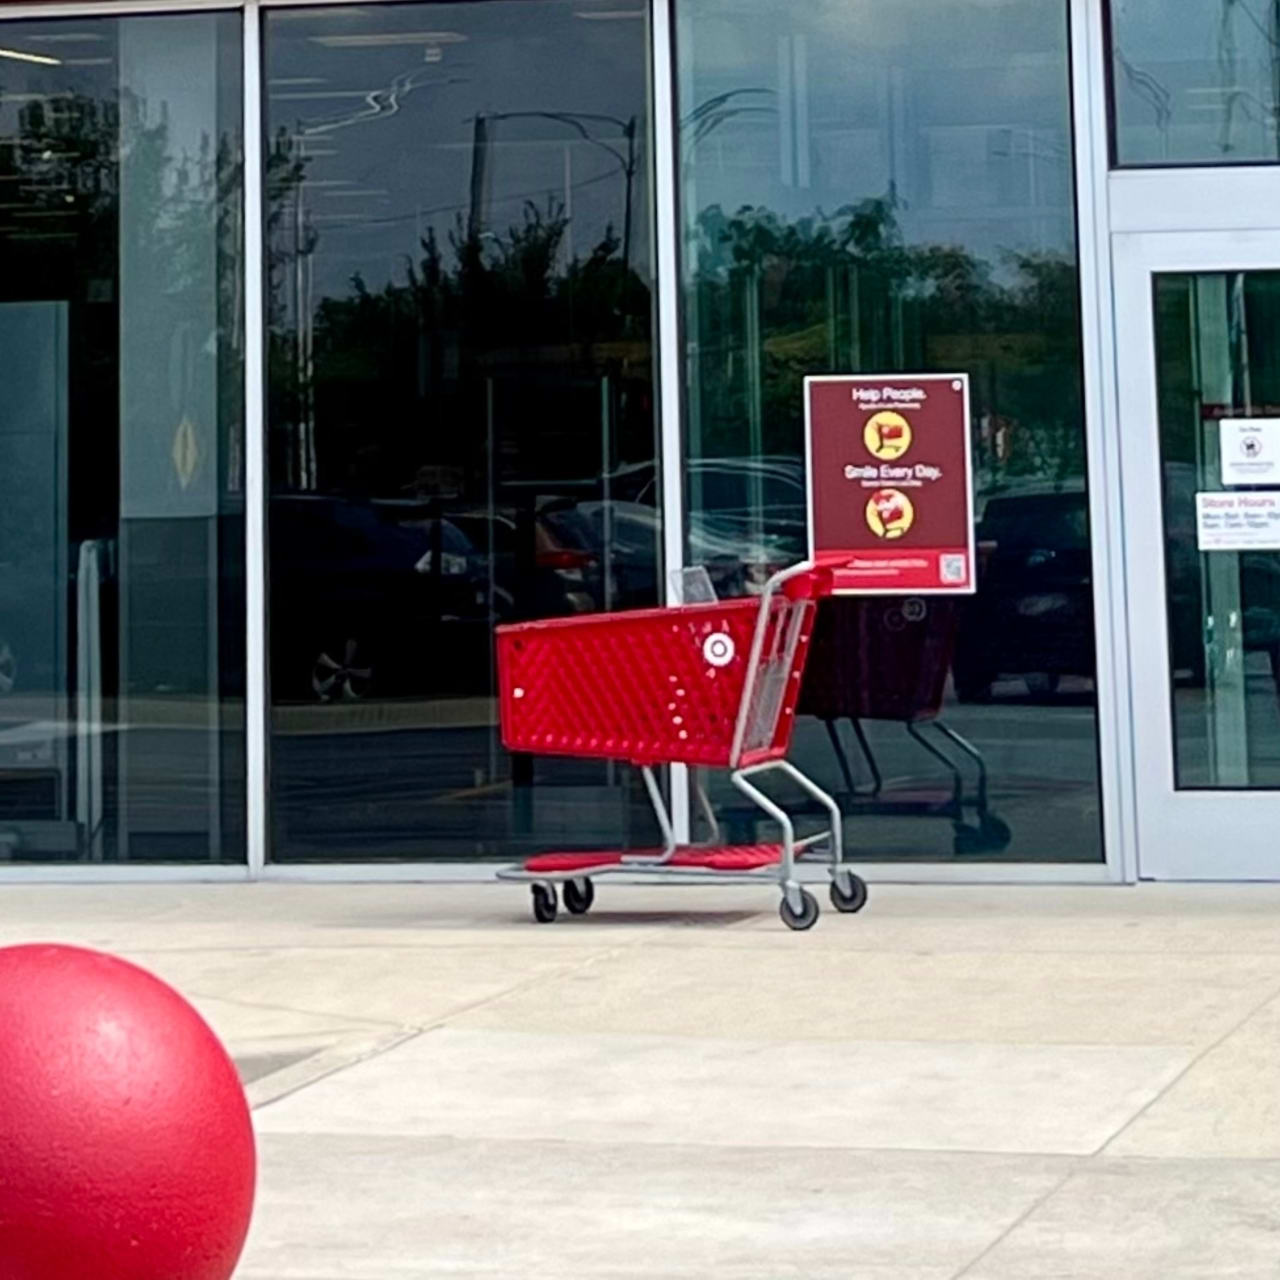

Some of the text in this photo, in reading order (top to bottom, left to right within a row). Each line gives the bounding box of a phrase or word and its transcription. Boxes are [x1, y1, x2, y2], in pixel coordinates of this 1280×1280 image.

[845, 464, 943, 481] Smile Every Day.
